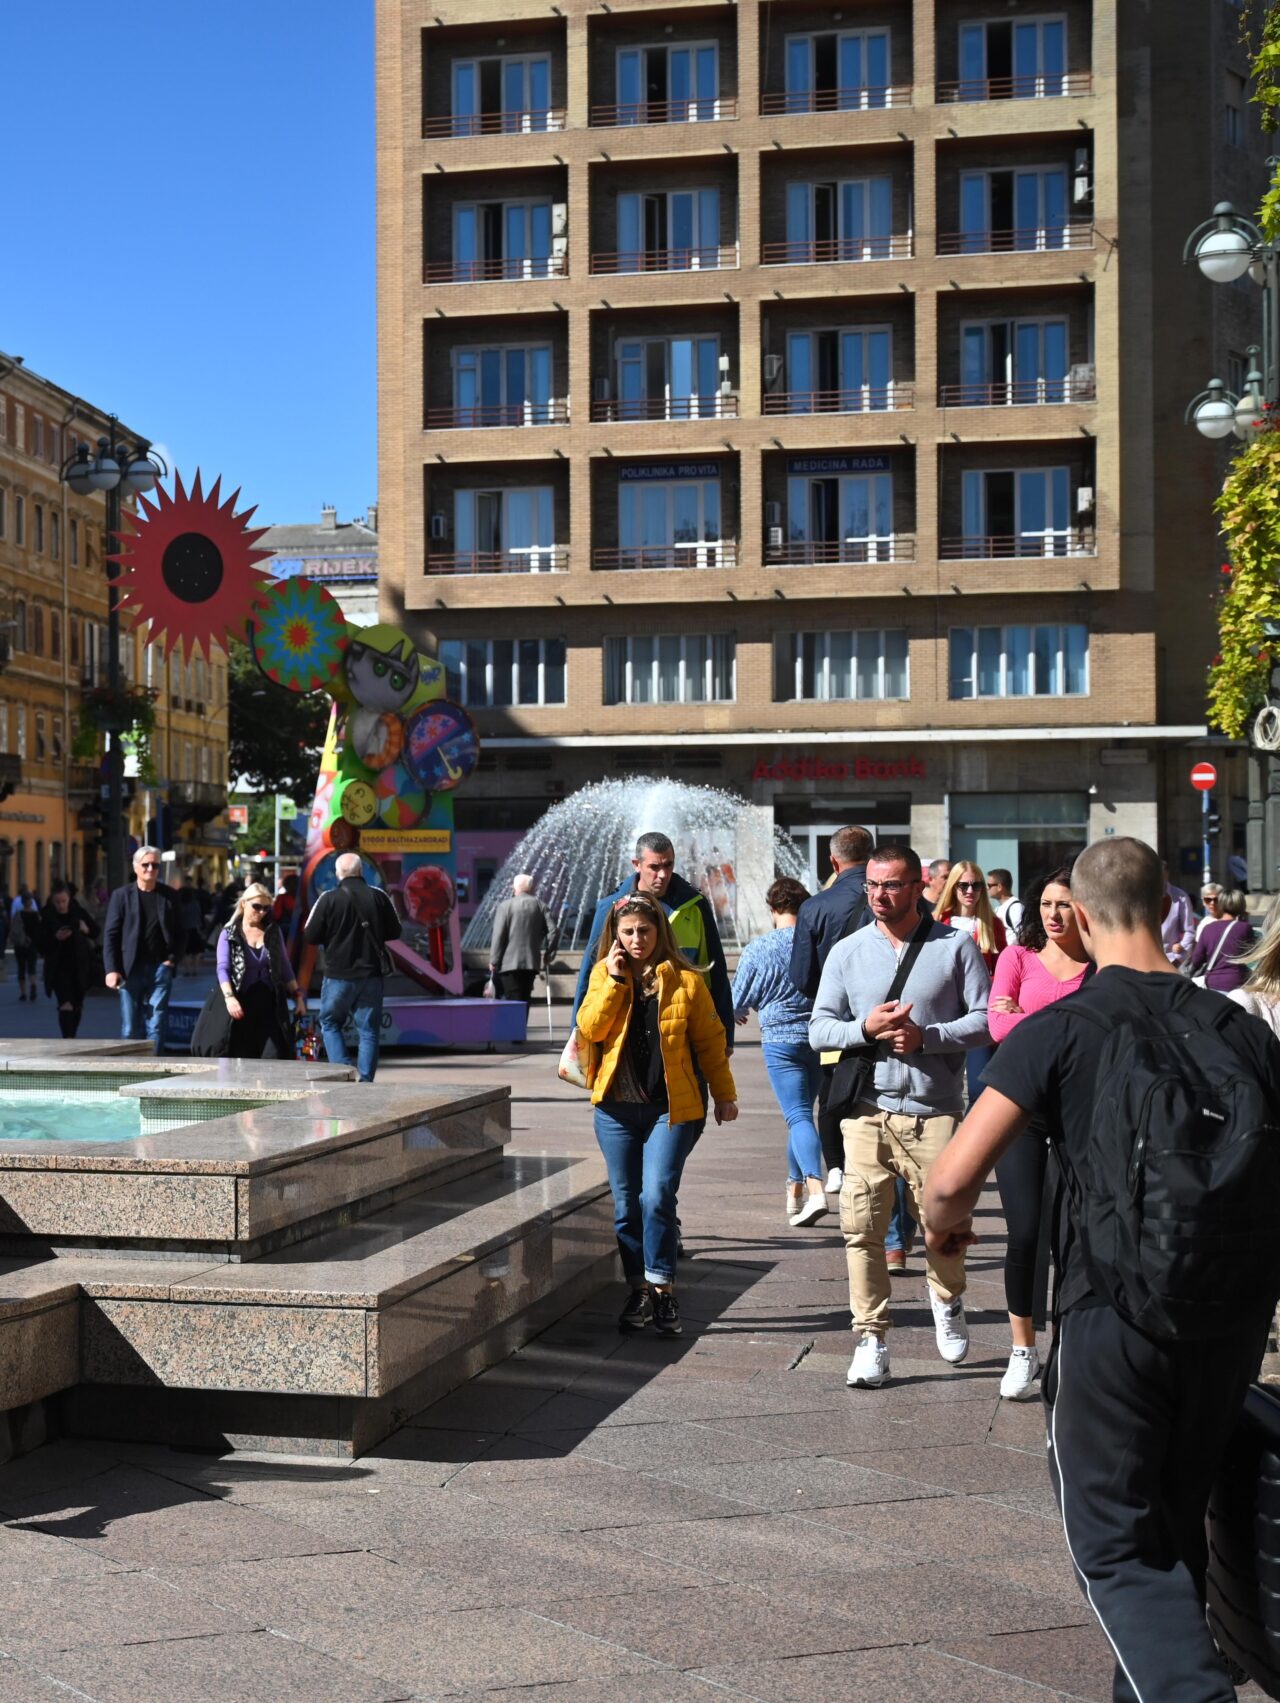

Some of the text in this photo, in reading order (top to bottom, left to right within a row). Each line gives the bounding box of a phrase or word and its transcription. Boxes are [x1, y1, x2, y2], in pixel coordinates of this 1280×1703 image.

[621, 464, 718, 478] POLIKLINIKA PRO VITA
[793, 458, 884, 471] MEDICINA RADA
[752, 753, 927, 781] Addiko Bank
